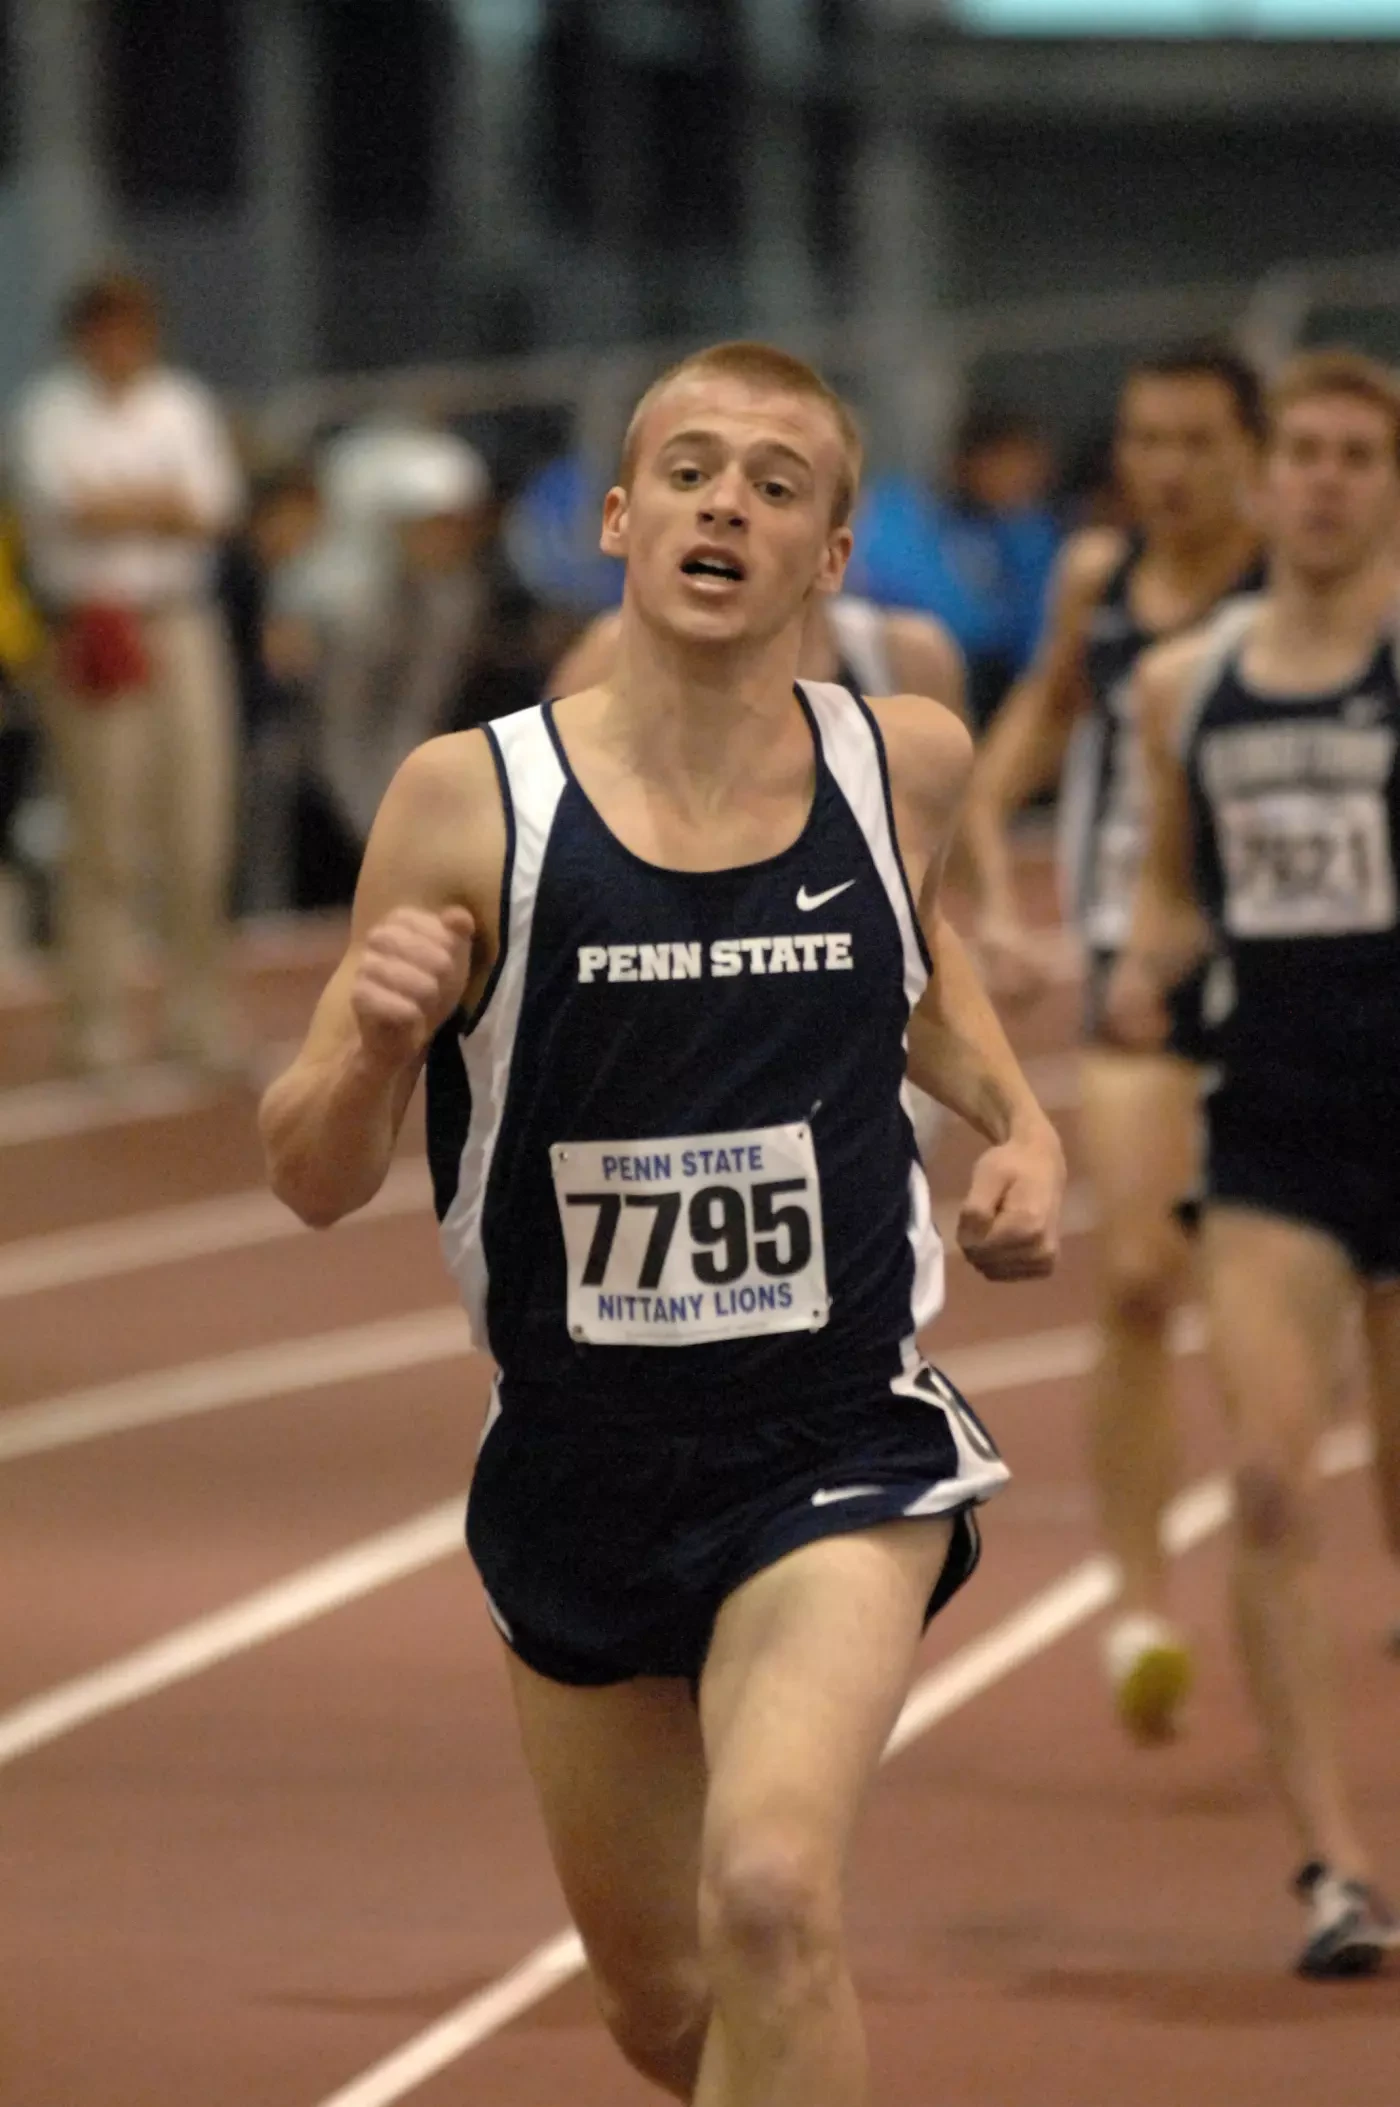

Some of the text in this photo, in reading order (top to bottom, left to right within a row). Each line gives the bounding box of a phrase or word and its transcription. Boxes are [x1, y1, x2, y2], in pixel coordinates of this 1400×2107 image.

[577, 932, 854, 983] PENN STATE
[601, 1145, 764, 1181] PENN STATE
[565, 1178, 812, 1290] 7795
[597, 1282, 793, 1323] NITTANY LIONS
